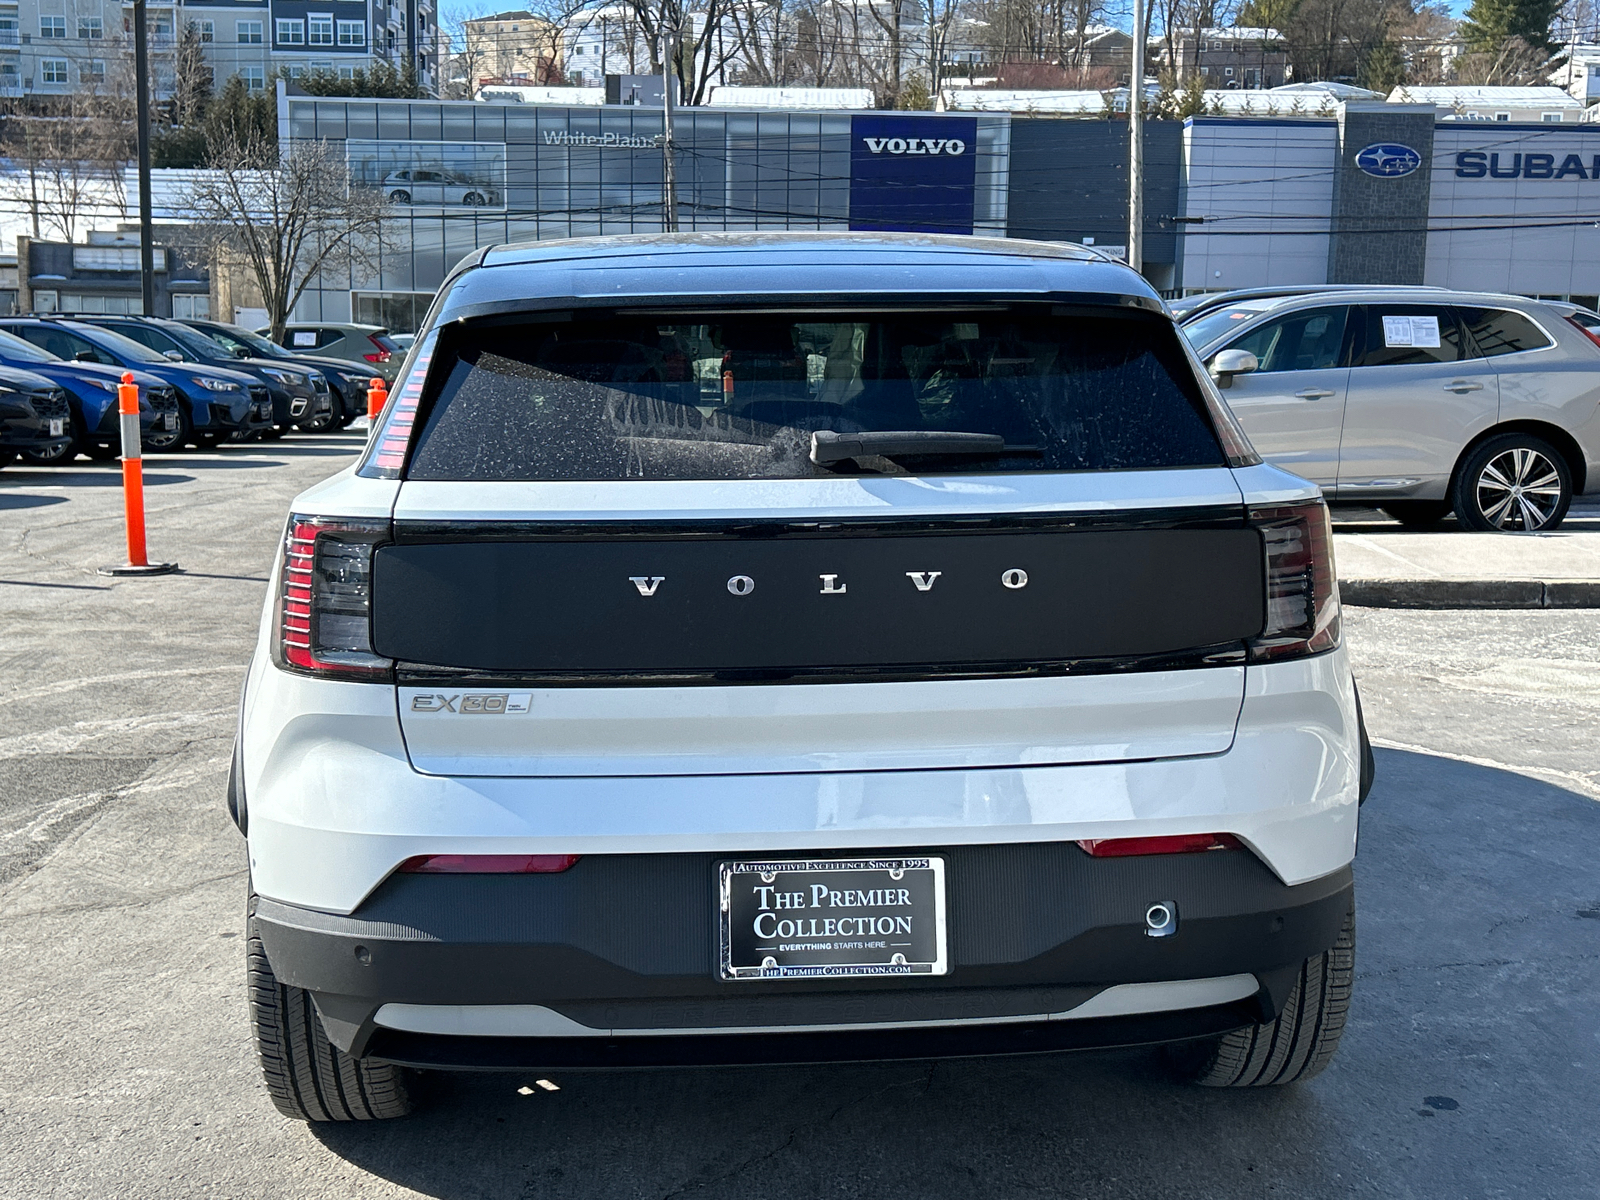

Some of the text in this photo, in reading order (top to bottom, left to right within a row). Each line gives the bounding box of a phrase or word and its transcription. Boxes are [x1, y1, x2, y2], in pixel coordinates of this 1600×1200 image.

[543, 130, 657, 148] White Plains
[863, 137, 966, 155] VOLVO
[1455, 151, 1600, 179] SUBA
[628, 567, 1029, 597] VOLVO
[411, 693, 509, 714] EX30
[868, 859, 898, 869] SINCE
[901, 859, 928, 869] 1995
[753, 884, 912, 910] THE PREMIER
[753, 912, 913, 939] COLLECTION
[779, 943, 832, 951] EVERYTHING
[833, 941, 863, 949] STARTS
